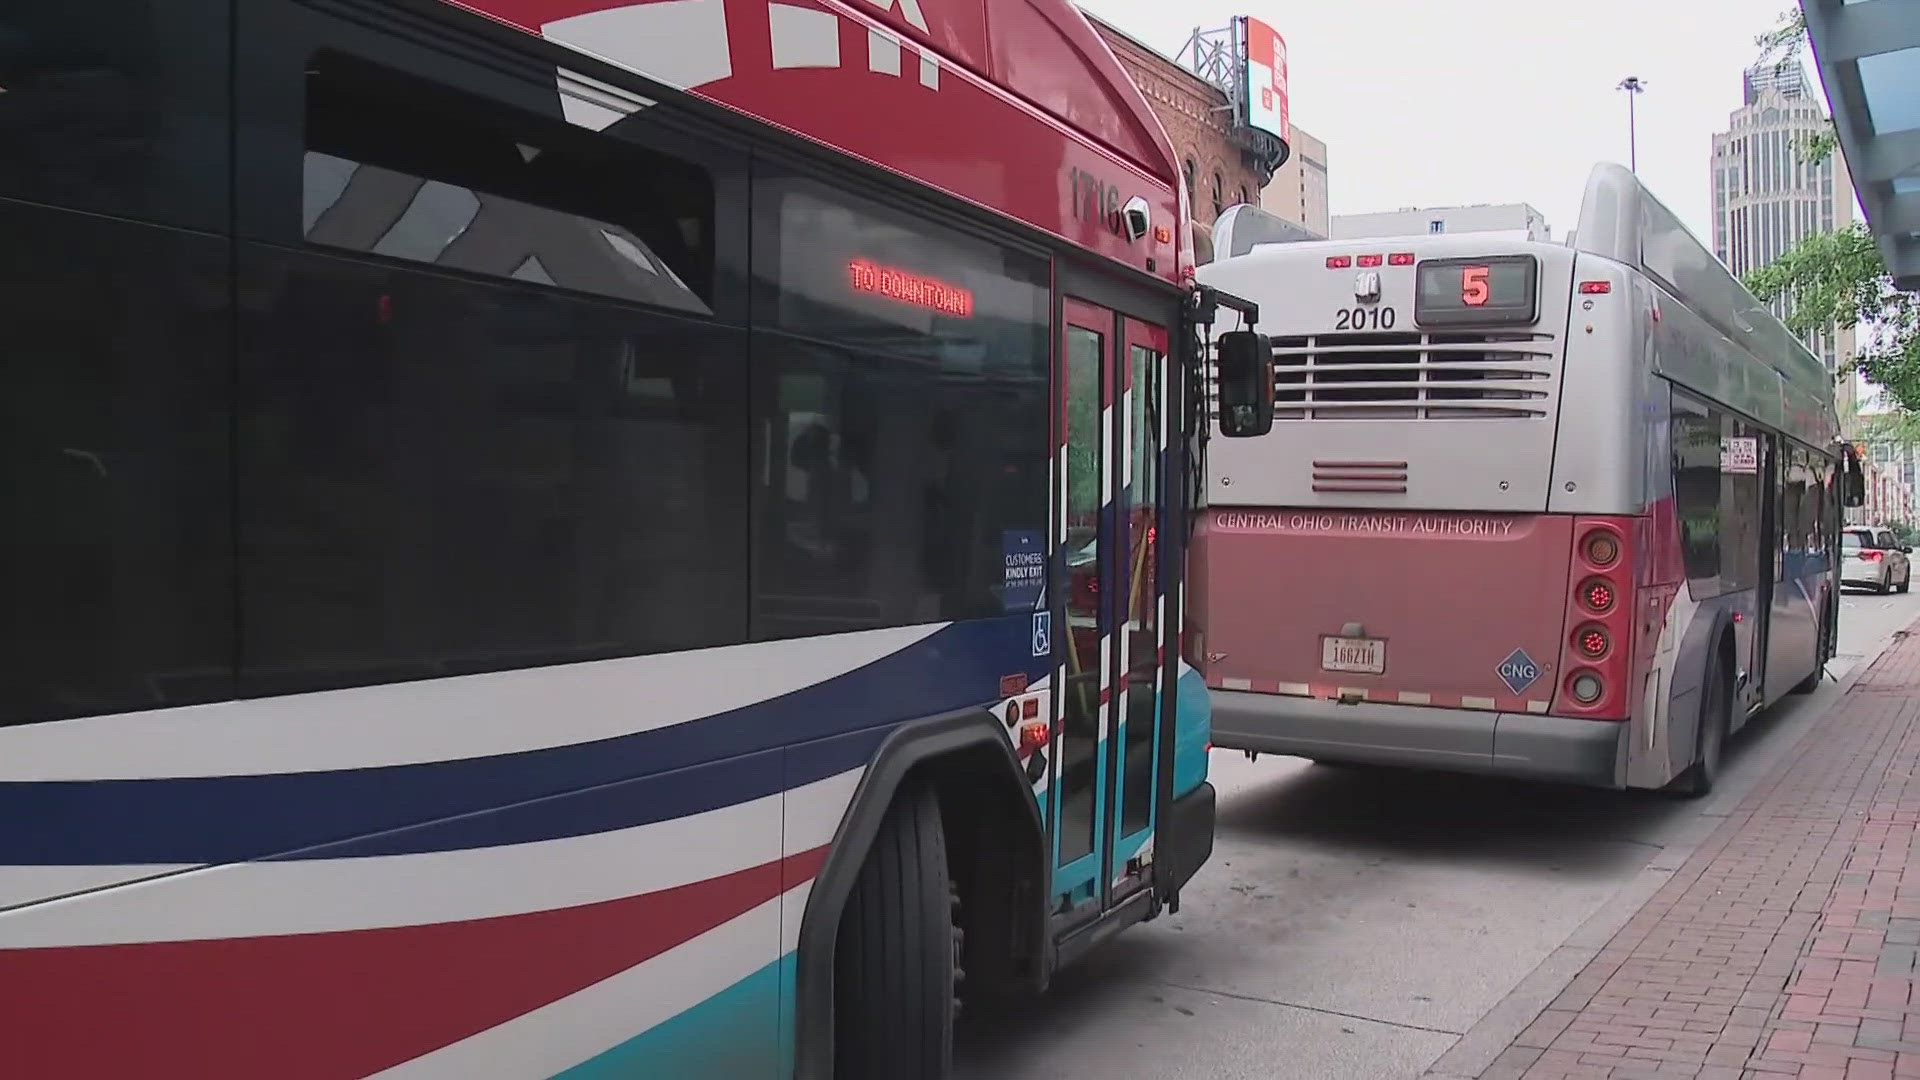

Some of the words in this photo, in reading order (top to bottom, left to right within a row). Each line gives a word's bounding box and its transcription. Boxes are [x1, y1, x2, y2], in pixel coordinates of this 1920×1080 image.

[1071, 166, 1119, 235] 1716
[850, 262, 874, 291] TO
[881, 270, 966, 315] DOWNTOWN
[1462, 266, 1489, 306] 5
[1335, 307, 1395, 330] 2010
[1216, 513, 1285, 530] CENTRAL
[1290, 514, 1333, 531] OHIO
[1339, 515, 1407, 533] TRANSIT
[1412, 517, 1513, 536] AUTHORITY
[1005, 567, 1028, 580] KINDLY
[1029, 566, 1043, 578] EXIT
[1501, 663, 1535, 679] CNG
